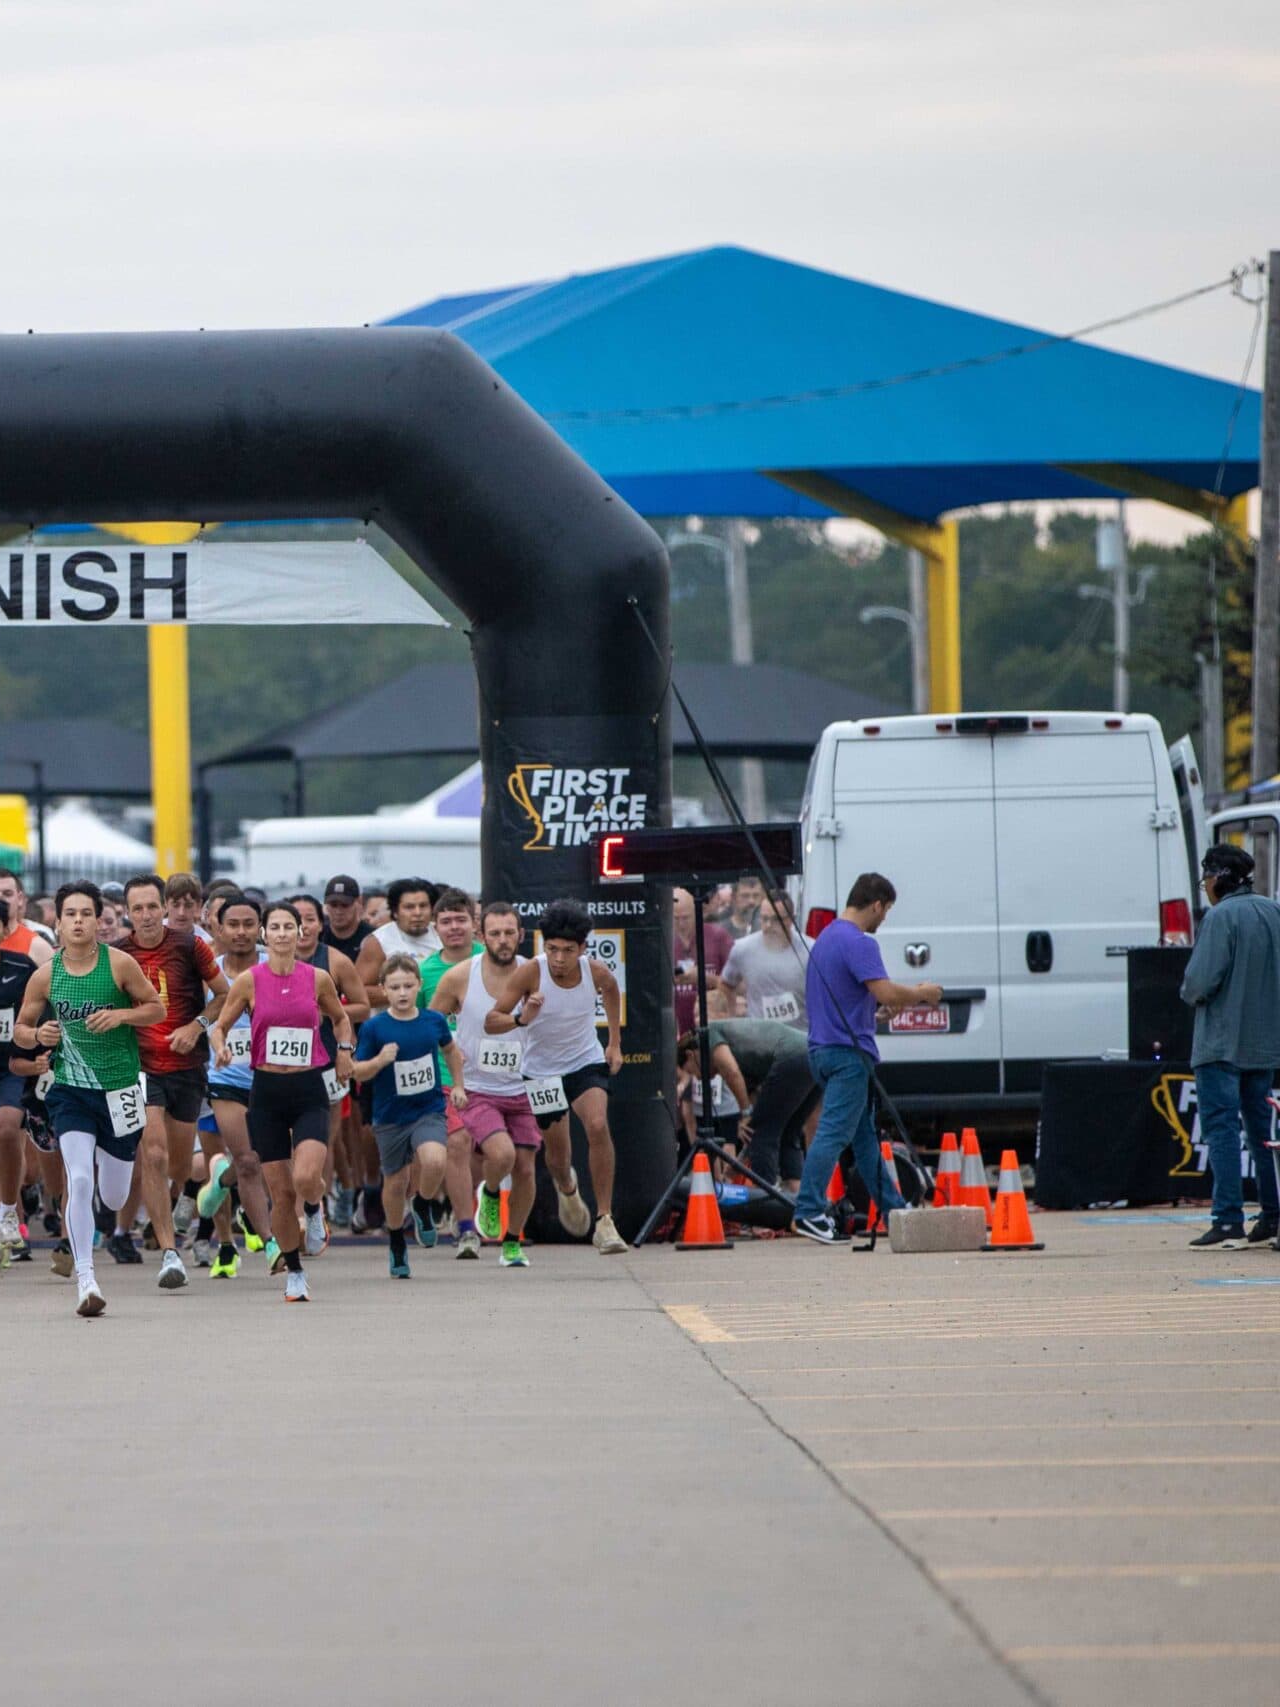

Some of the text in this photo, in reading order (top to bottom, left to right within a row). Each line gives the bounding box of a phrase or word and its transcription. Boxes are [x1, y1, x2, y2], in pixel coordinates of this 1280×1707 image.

[530, 768, 630, 797] FIRST
[542, 794, 647, 822] PLACE
[545, 821, 645, 846] TIM
[587, 902, 646, 915] RESULTS
[227, 1040, 251, 1056] 154
[271, 1040, 308, 1057] 1250
[482, 1051, 517, 1067] 1333
[400, 1067, 433, 1088] 1528
[530, 1088, 560, 1107] 1567
[120, 1090, 140, 1129] 1422
